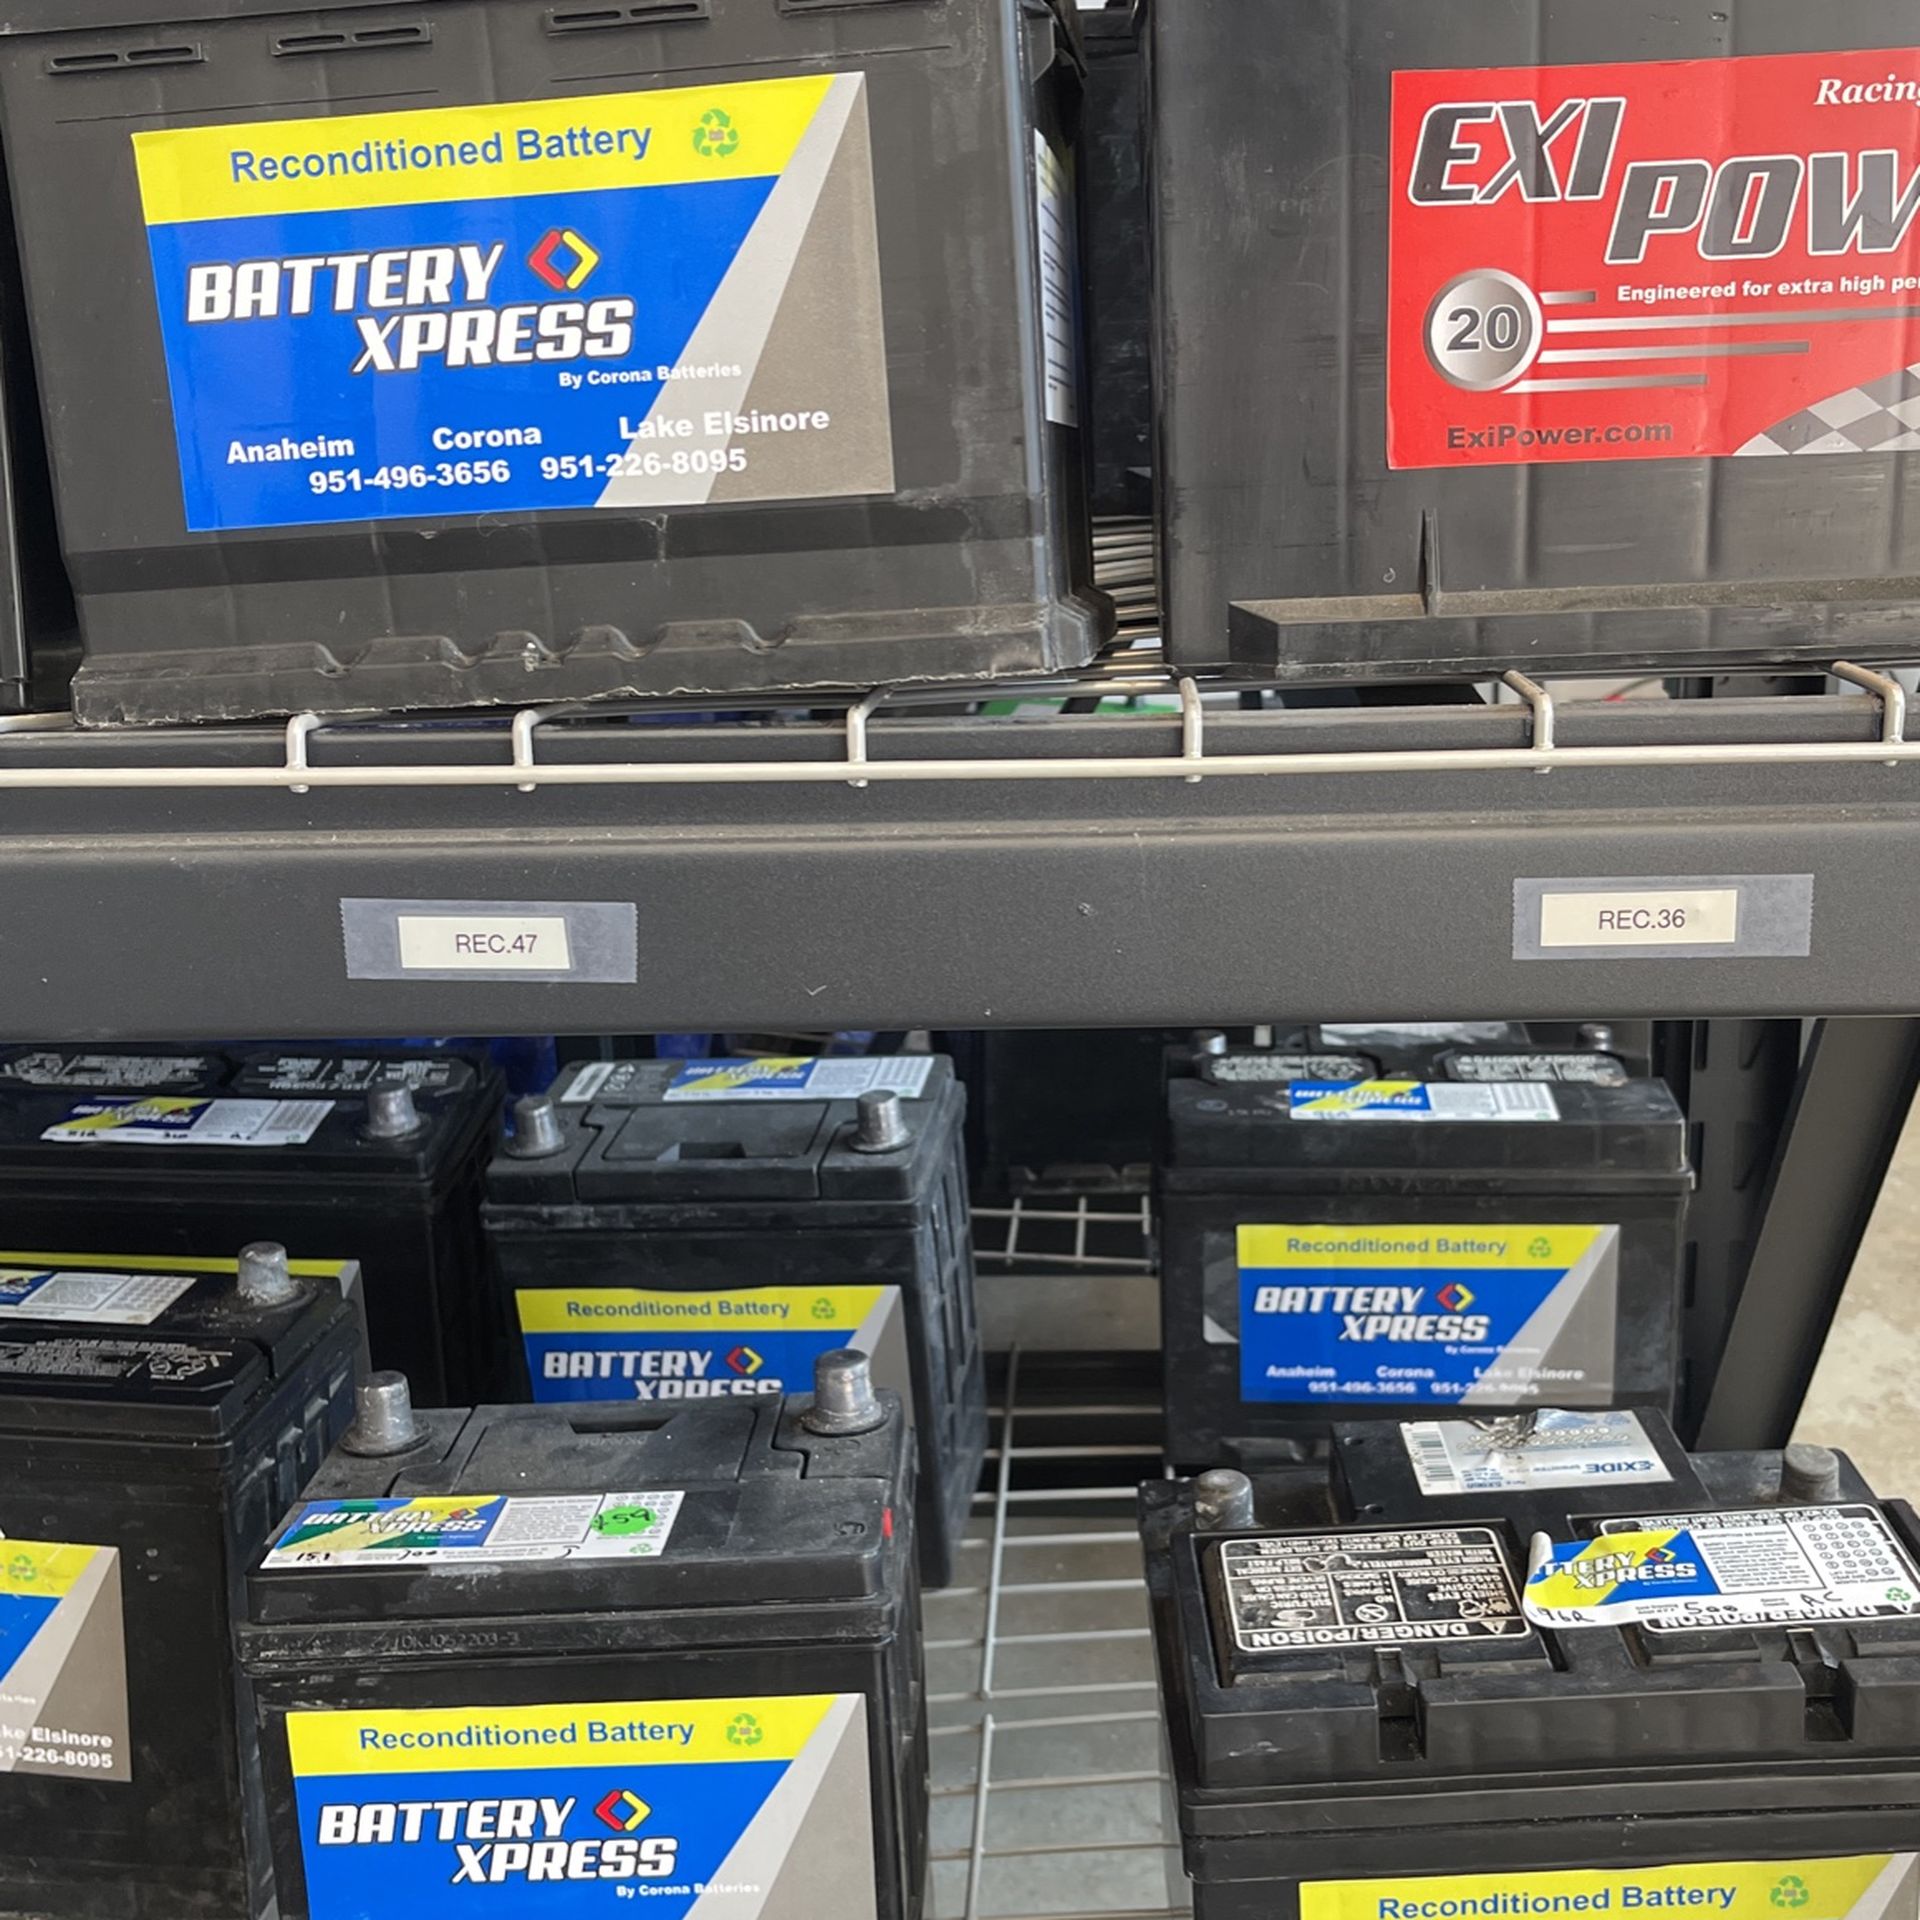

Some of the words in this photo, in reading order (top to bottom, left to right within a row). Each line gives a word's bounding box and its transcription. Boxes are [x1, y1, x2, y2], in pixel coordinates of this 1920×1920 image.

[1813, 73, 1920, 107] Racin
[230, 131, 502, 184] Reconditioned
[517, 124, 653, 162] Battery
[1408, 97, 1626, 206] EXI
[186, 242, 504, 324] BATTERY
[1617, 281, 1736, 304] Engineered
[1743, 280, 1771, 296] for
[1778, 278, 1833, 295] extra
[1840, 274, 1885, 295] high
[1891, 276, 1920, 294] pe
[352, 297, 635, 375] XPRESS
[1446, 304, 1521, 352] 20
[559, 372, 582, 389] By
[587, 369, 651, 385] Corona
[657, 363, 742, 381] Batteries
[226, 435, 355, 464] Anaheim
[432, 426, 542, 450] Corona
[619, 415, 693, 440] Lake
[703, 410, 830, 436] Elsinore
[1446, 421, 1672, 450] ExiPower.com
[309, 459, 510, 494] 951-496-3656
[541, 448, 747, 480] 951-226-8095
[1598, 908, 1686, 930] REC.36
[456, 933, 538, 954] REC.47
[1287, 1237, 1429, 1254] Reconditioned
[1437, 1238, 1507, 1256] Battery
[567, 1300, 711, 1318] Reconditioned
[719, 1300, 790, 1319] Battery
[1253, 1285, 1424, 1314] BATTERY
[1339, 1314, 1490, 1342] XPRESS
[544, 1348, 712, 1379] BATTERY
[1266, 1365, 1336, 1379] Anaheim
[1376, 1365, 1436, 1379] Corona
[1583, 1460, 1655, 1474] EXIDE
[303, 1509, 433, 1525] BATTERY
[368, 1519, 486, 1534] XPRESS
[1537, 1551, 1635, 1576] TTERY
[1574, 1563, 1697, 1588] XPRESS
[1250, 1622, 1469, 1646] DANGER/POISON
[32, 1726, 113, 1748] Elsinore
[360, 1722, 577, 1749] Reconditioned
[587, 1719, 695, 1745] Battery
[318, 1796, 577, 1845] BATTERY
[451, 1837, 678, 1884] XPRESS
[616, 1885, 635, 1898] By
[639, 1884, 690, 1896] Corona
[1379, 1889, 1610, 1920] Reconditioned
[1622, 1885, 1736, 1909] Battery
